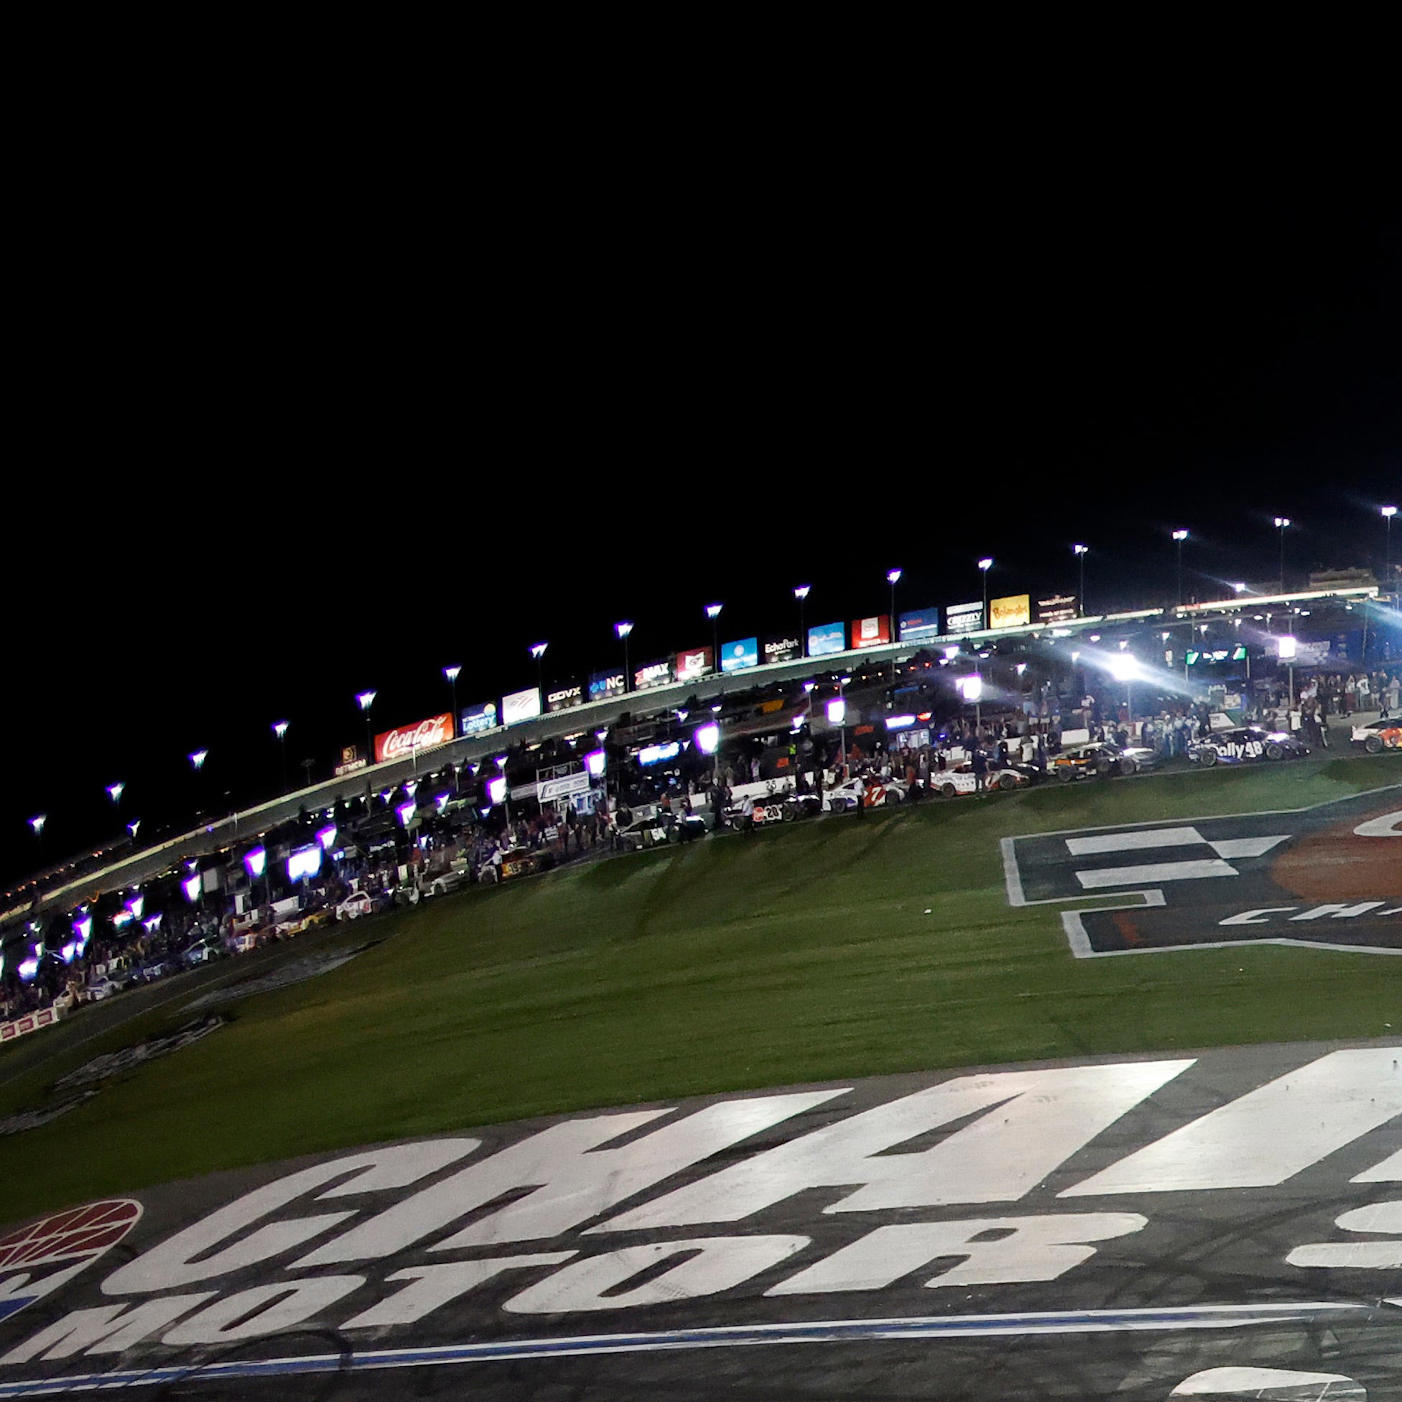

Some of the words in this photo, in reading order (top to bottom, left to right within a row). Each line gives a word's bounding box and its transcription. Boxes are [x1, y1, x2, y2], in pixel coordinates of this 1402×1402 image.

[765, 638, 799, 654] EchoPark
[606, 674, 624, 690] NC
[870, 786, 882, 802] 7
[766, 803, 780, 819] 20
[3, 1211, 1149, 1364] MOTOR
